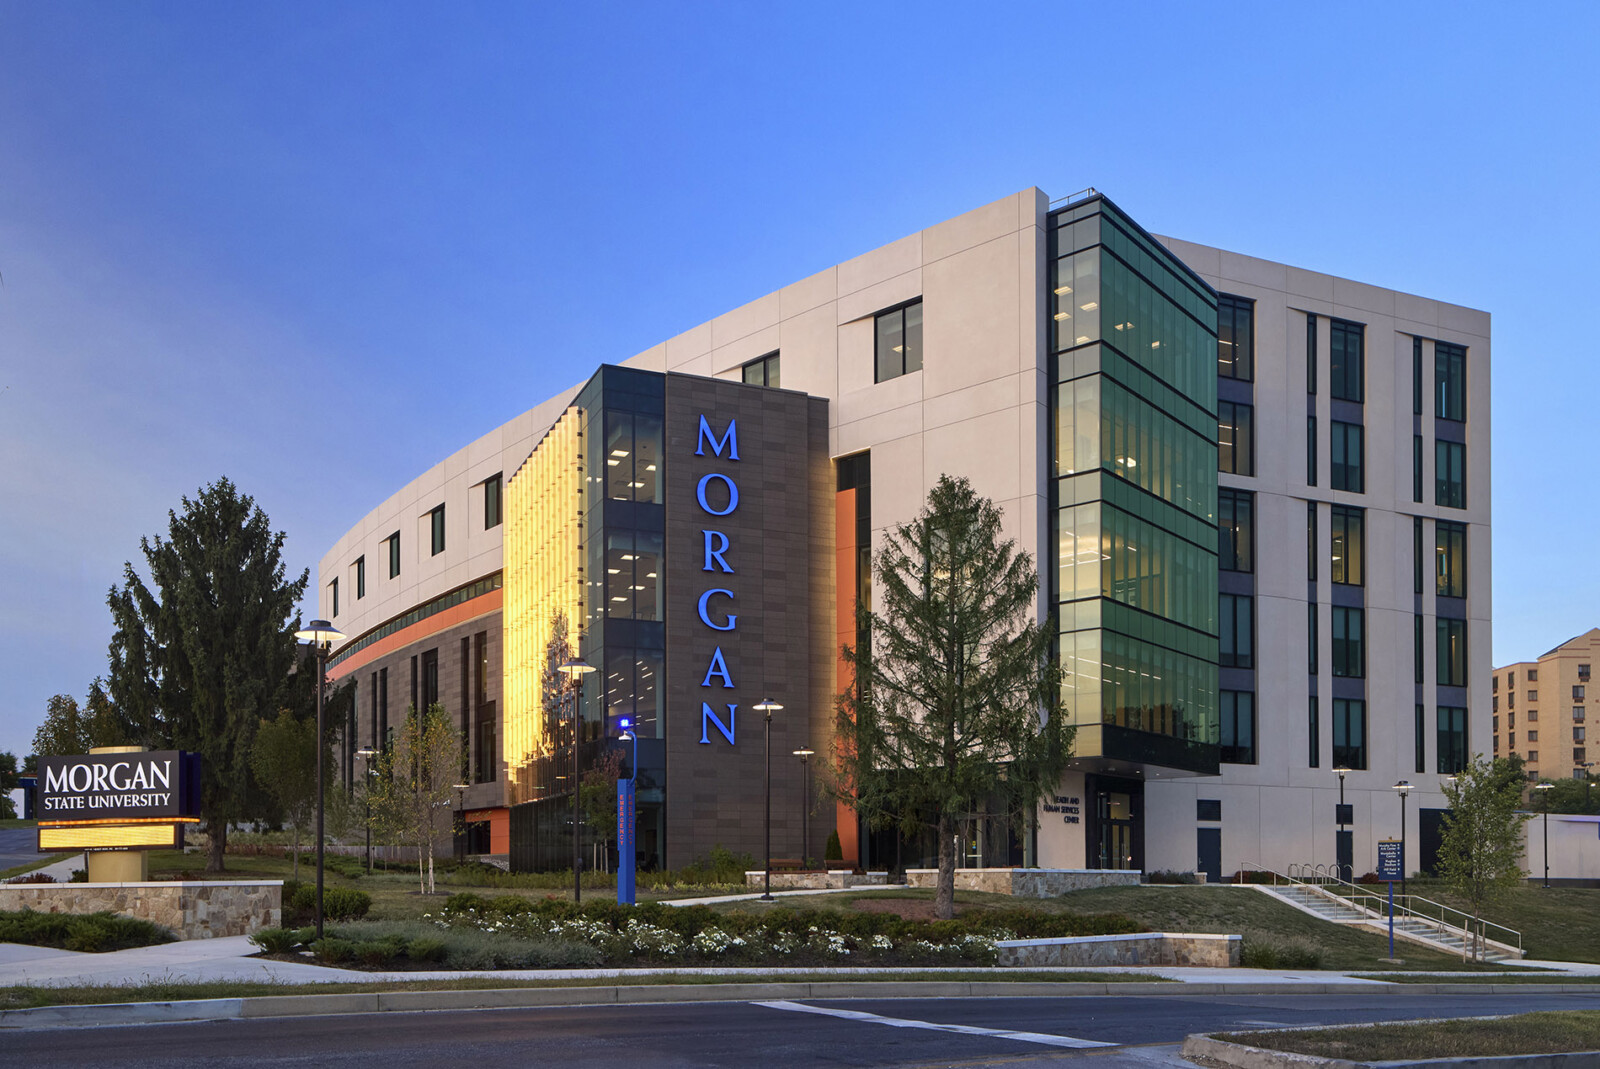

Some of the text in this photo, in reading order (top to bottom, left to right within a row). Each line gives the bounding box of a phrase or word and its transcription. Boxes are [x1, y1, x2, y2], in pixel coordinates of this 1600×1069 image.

[695, 414, 740, 745] MORGAN
[44, 761, 171, 793] MORGAN
[44, 793, 171, 810] STATE UNIVERSITY
[1061, 806, 1079, 815] SERVICES
[1064, 816, 1079, 824] CENTER
